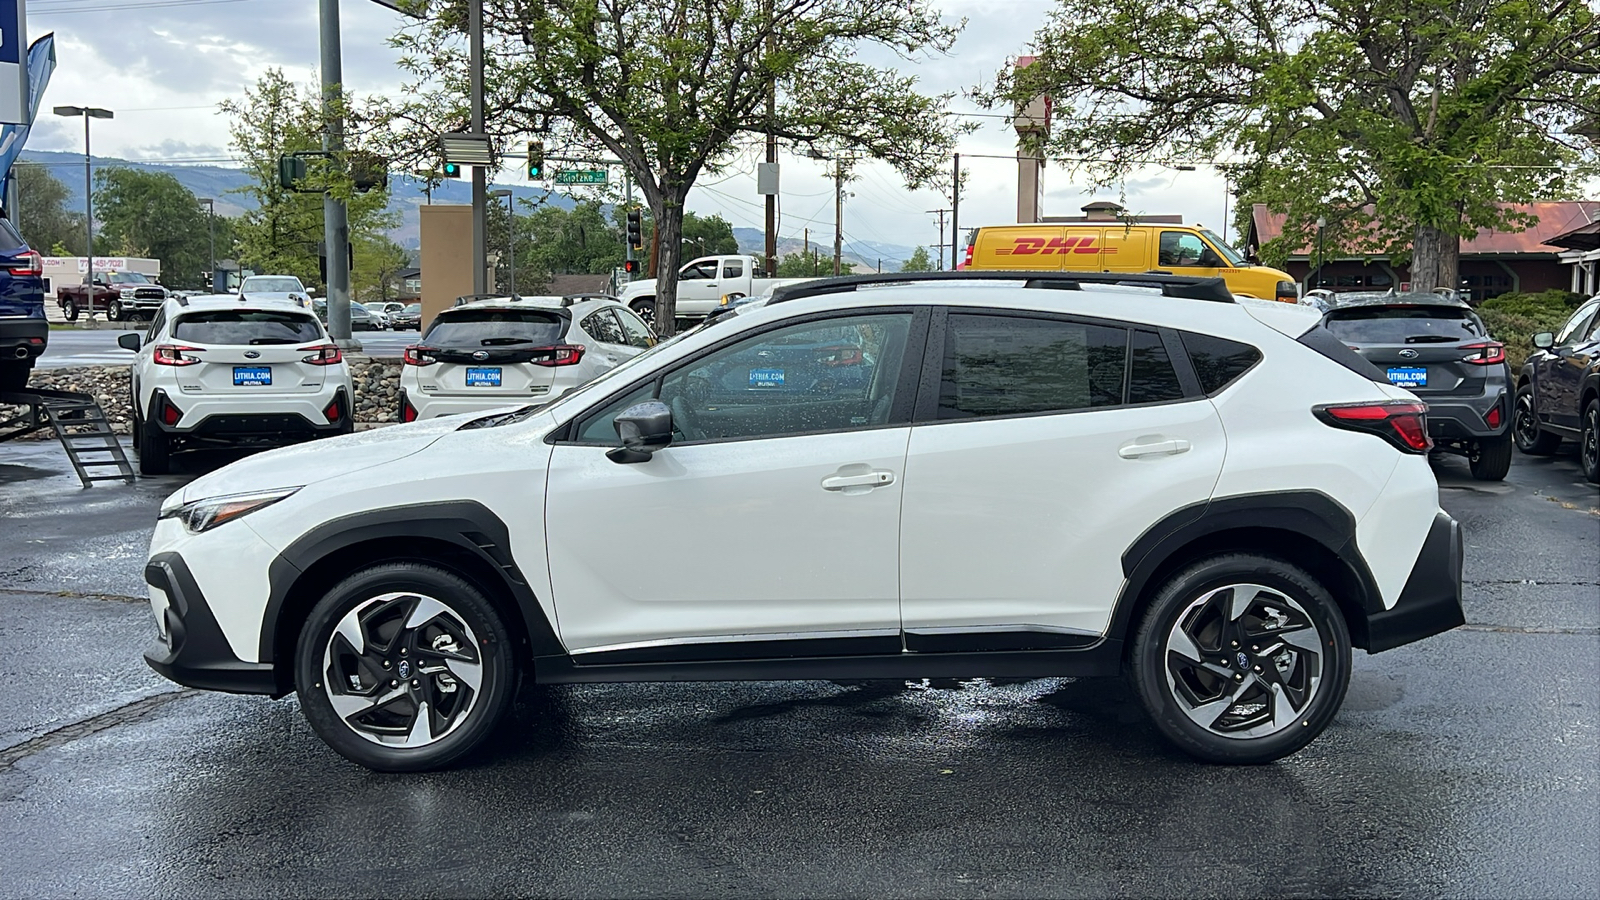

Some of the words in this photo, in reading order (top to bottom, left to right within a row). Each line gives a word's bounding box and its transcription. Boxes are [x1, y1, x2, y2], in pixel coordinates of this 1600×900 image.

[1012, 237, 1101, 255] DHL
[79, 259, 124, 267] 77-451-7021
[234, 372, 271, 380] LITHIA.COM
[467, 373, 501, 381] LITHIA.COM
[1387, 372, 1427, 381] LITHIA.COM
[461, 598, 497, 643] ALKEN
